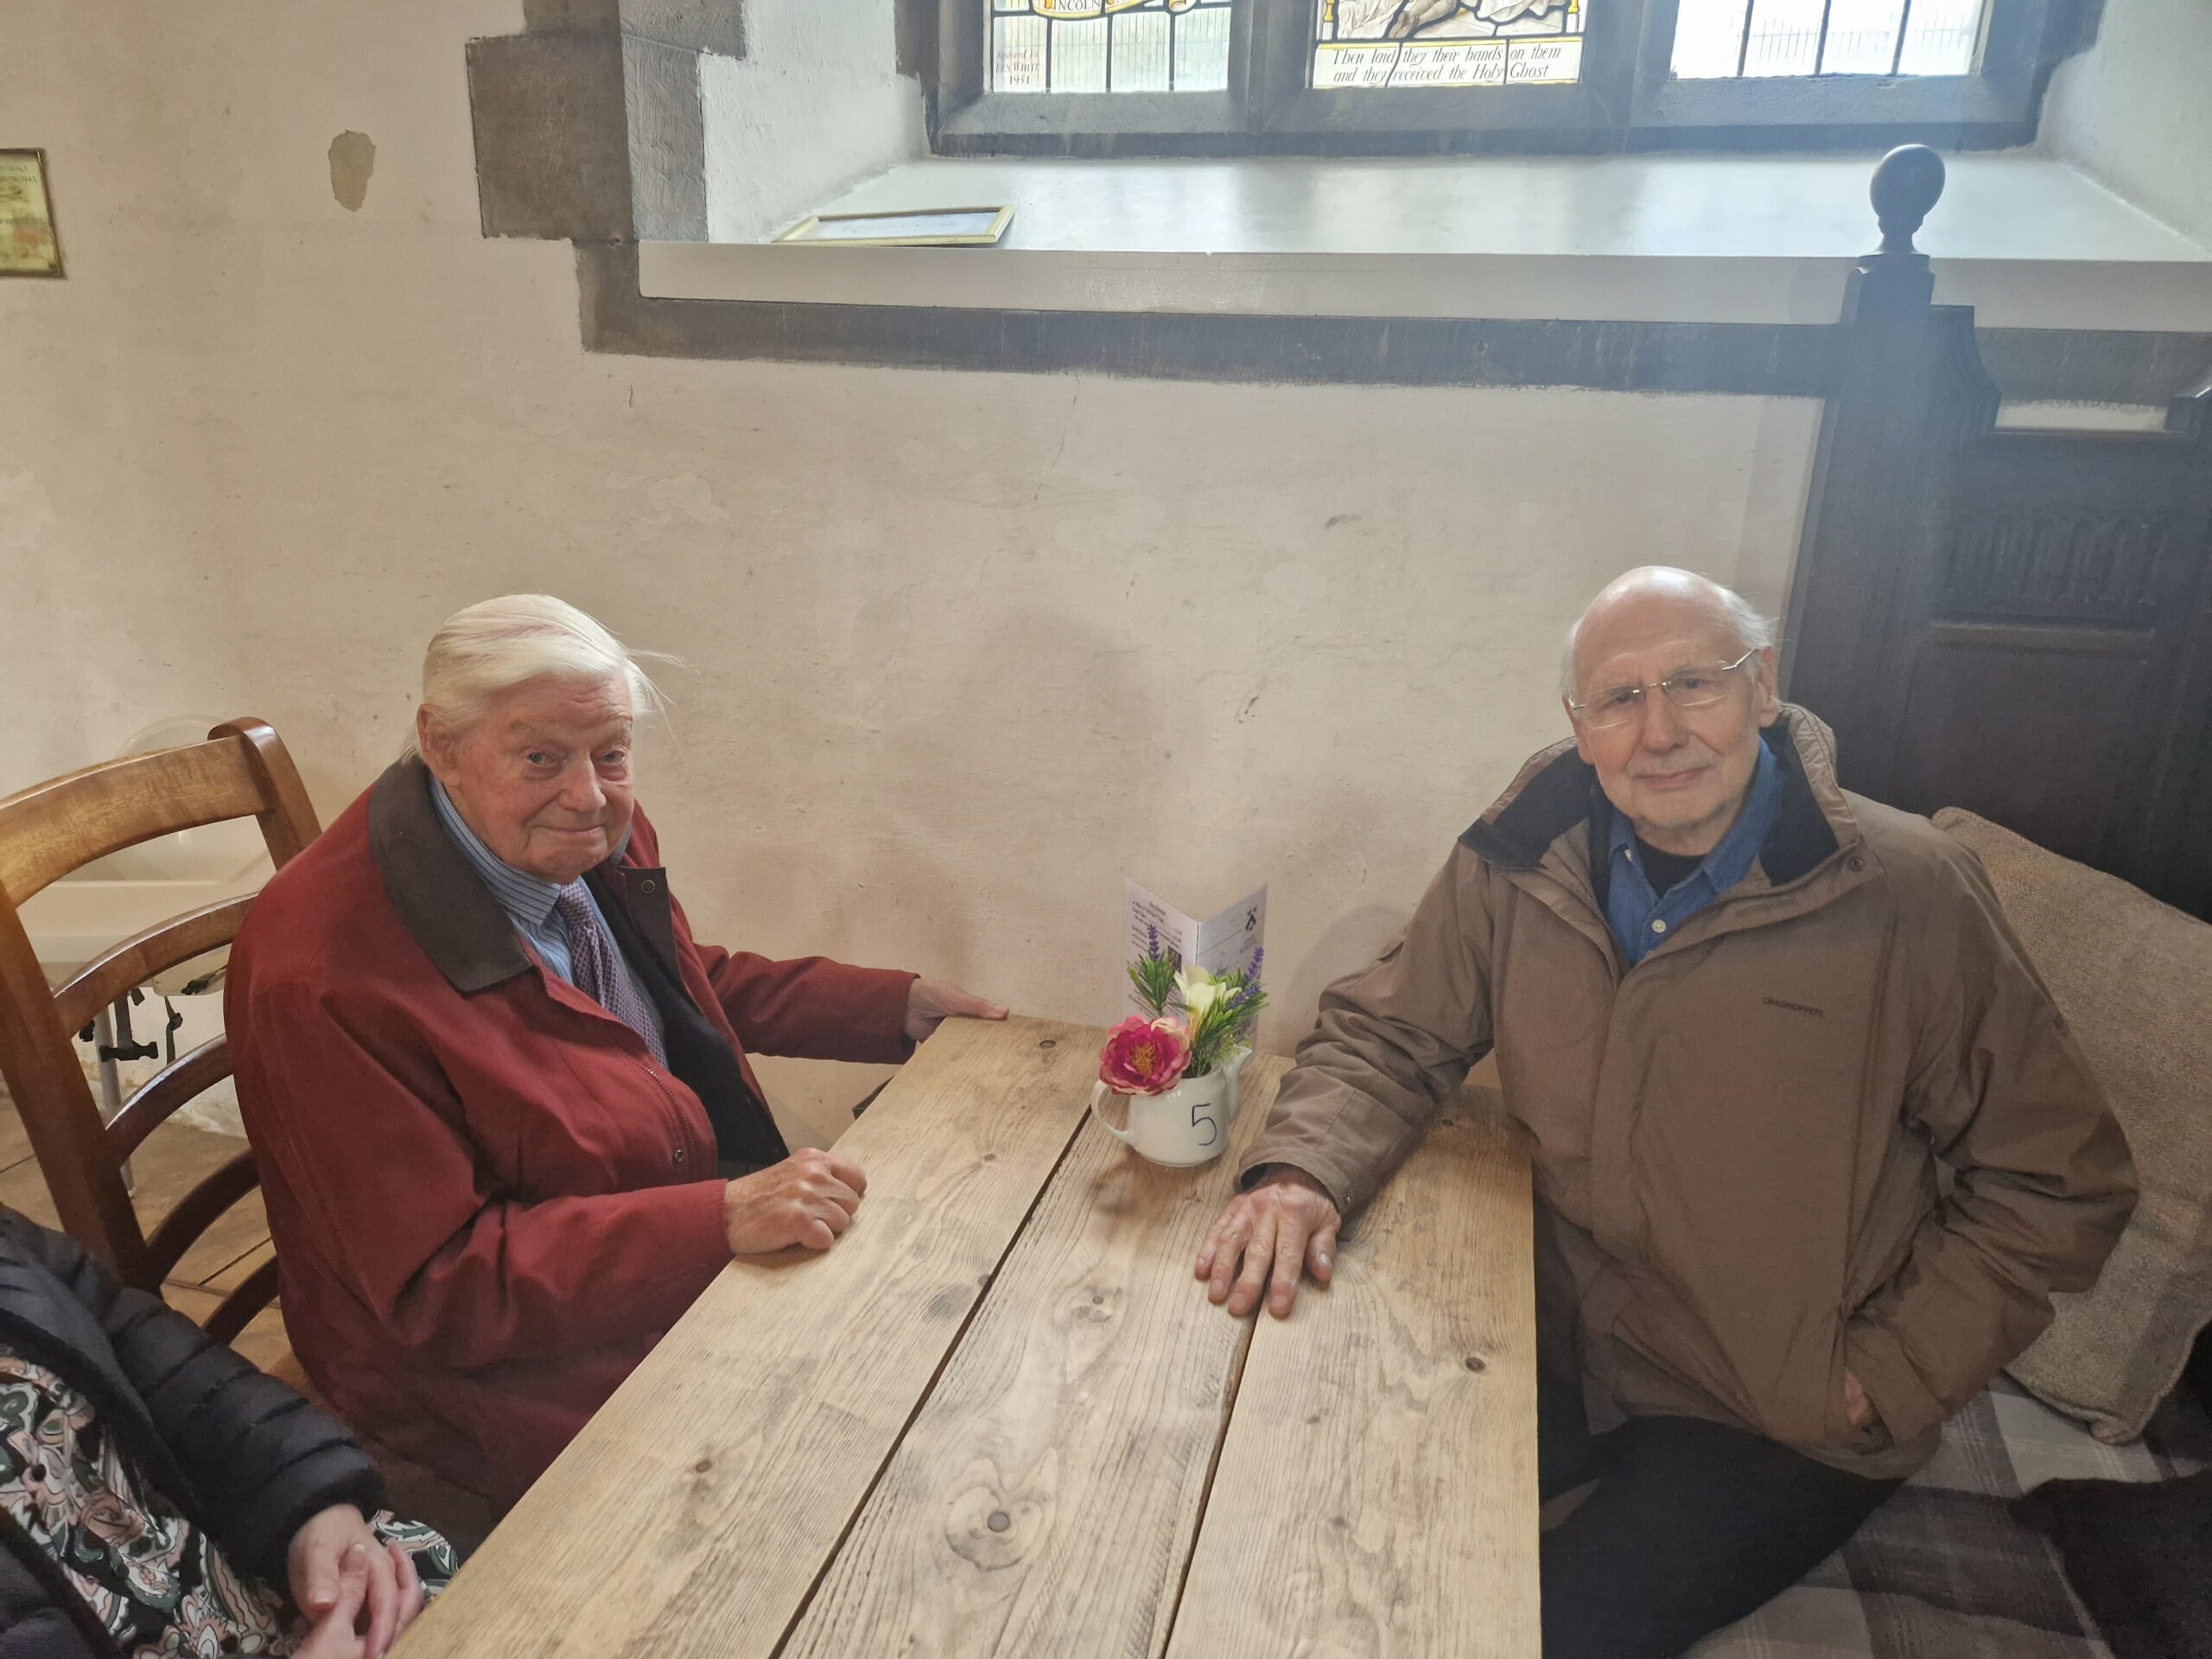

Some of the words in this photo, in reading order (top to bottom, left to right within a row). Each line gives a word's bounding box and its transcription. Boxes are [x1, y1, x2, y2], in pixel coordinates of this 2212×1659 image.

[1333, 49, 1364, 64] Then
[1371, 48, 1396, 64] laid
[1403, 48, 1427, 67] they
[1432, 47, 1460, 62] their
[1465, 46, 1503, 61] hands
[1510, 48, 1524, 60] on
[1531, 43, 1561, 60] them
[1009, 75, 1029, 85] 1951
[1334, 67, 1357, 82] and
[1363, 67, 1388, 85] they
[1393, 65, 1444, 81] received
[1449, 64, 1467, 79] the
[1472, 63, 1503, 82] Holy
[1510, 61, 1549, 79] Ghost
[1192, 1103, 1217, 1146] 5
